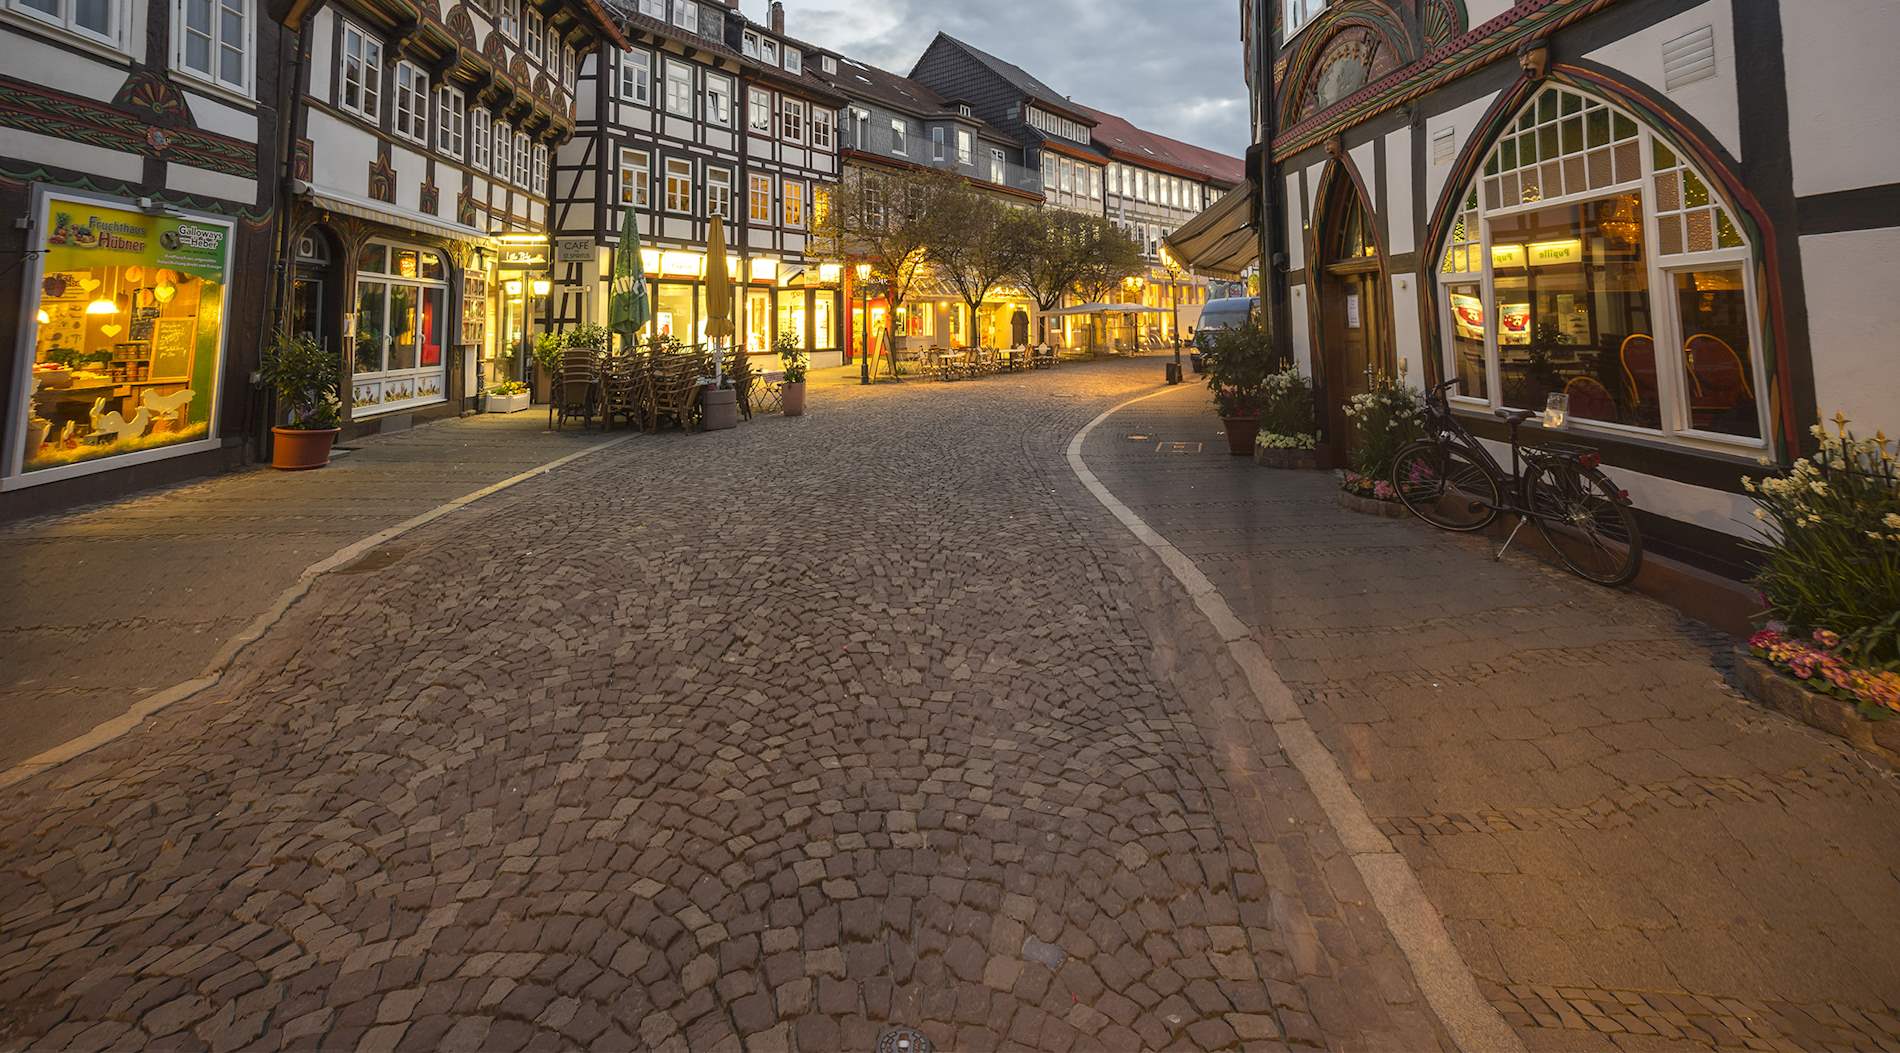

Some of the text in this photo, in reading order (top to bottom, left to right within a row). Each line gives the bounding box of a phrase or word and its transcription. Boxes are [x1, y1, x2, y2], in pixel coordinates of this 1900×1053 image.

[89, 216, 145, 236] Fruchthaus
[179, 225, 223, 241] Galloways
[97, 231, 145, 251] Hübner
[191, 238, 217, 249] Heber
[564, 240, 589, 250] CAFÉ
